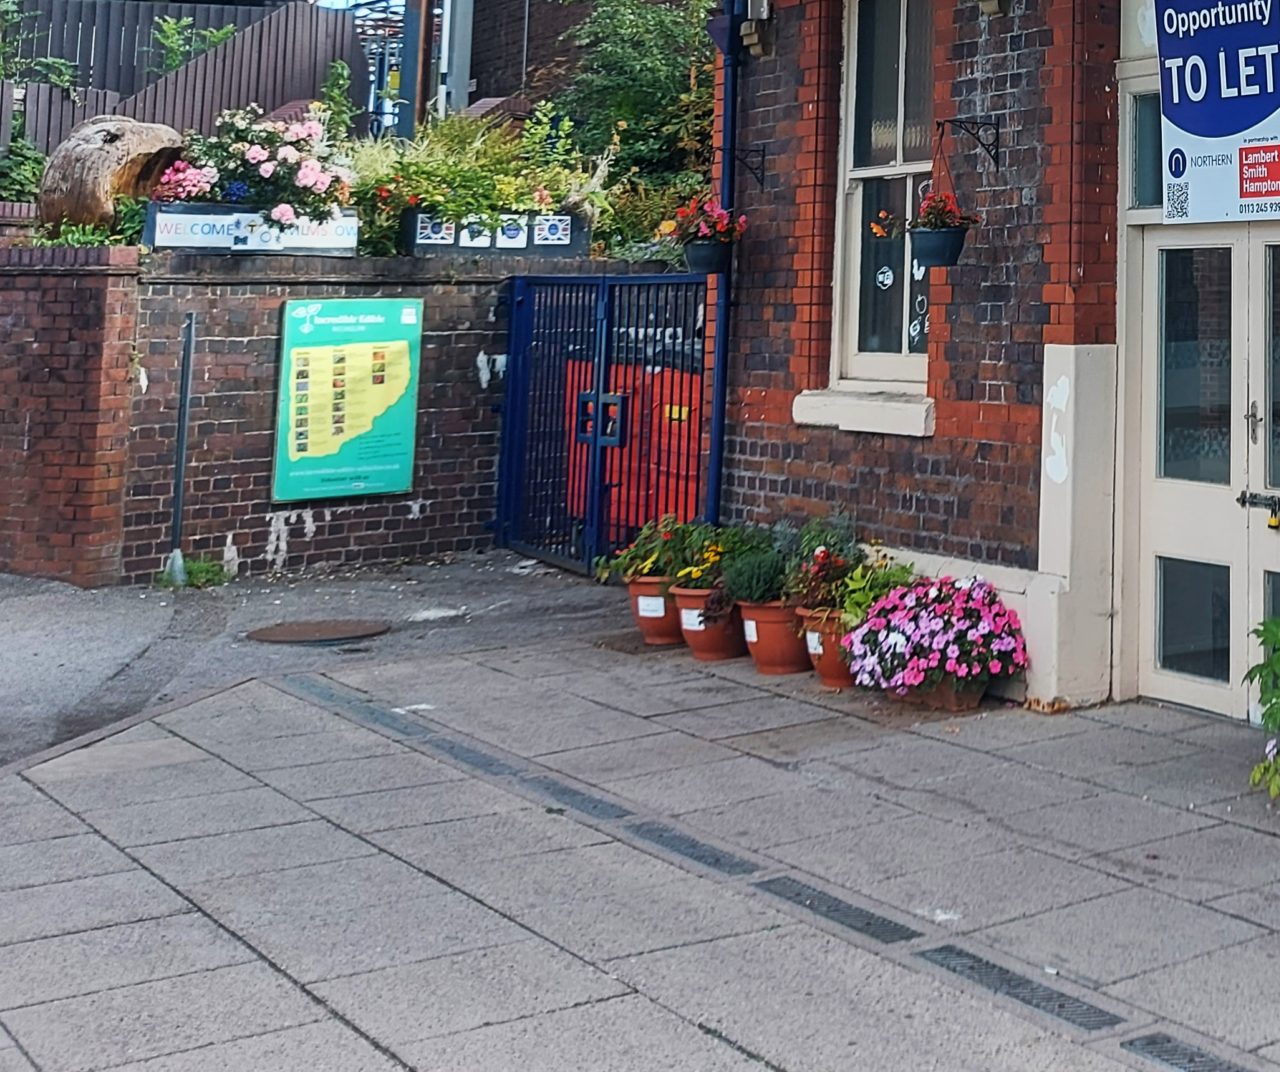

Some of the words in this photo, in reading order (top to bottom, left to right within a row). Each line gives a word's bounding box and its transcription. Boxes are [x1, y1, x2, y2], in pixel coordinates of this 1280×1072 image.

[1164, 54, 1208, 104] TO
[1218, 44, 1279, 98] LET
[1190, 153, 1233, 168] NORTHERN
[1242, 150, 1279, 164] Lambert
[1242, 165, 1268, 178] Smith
[1239, 203, 1255, 214] 0113
[1255, 202, 1269, 214] 245
